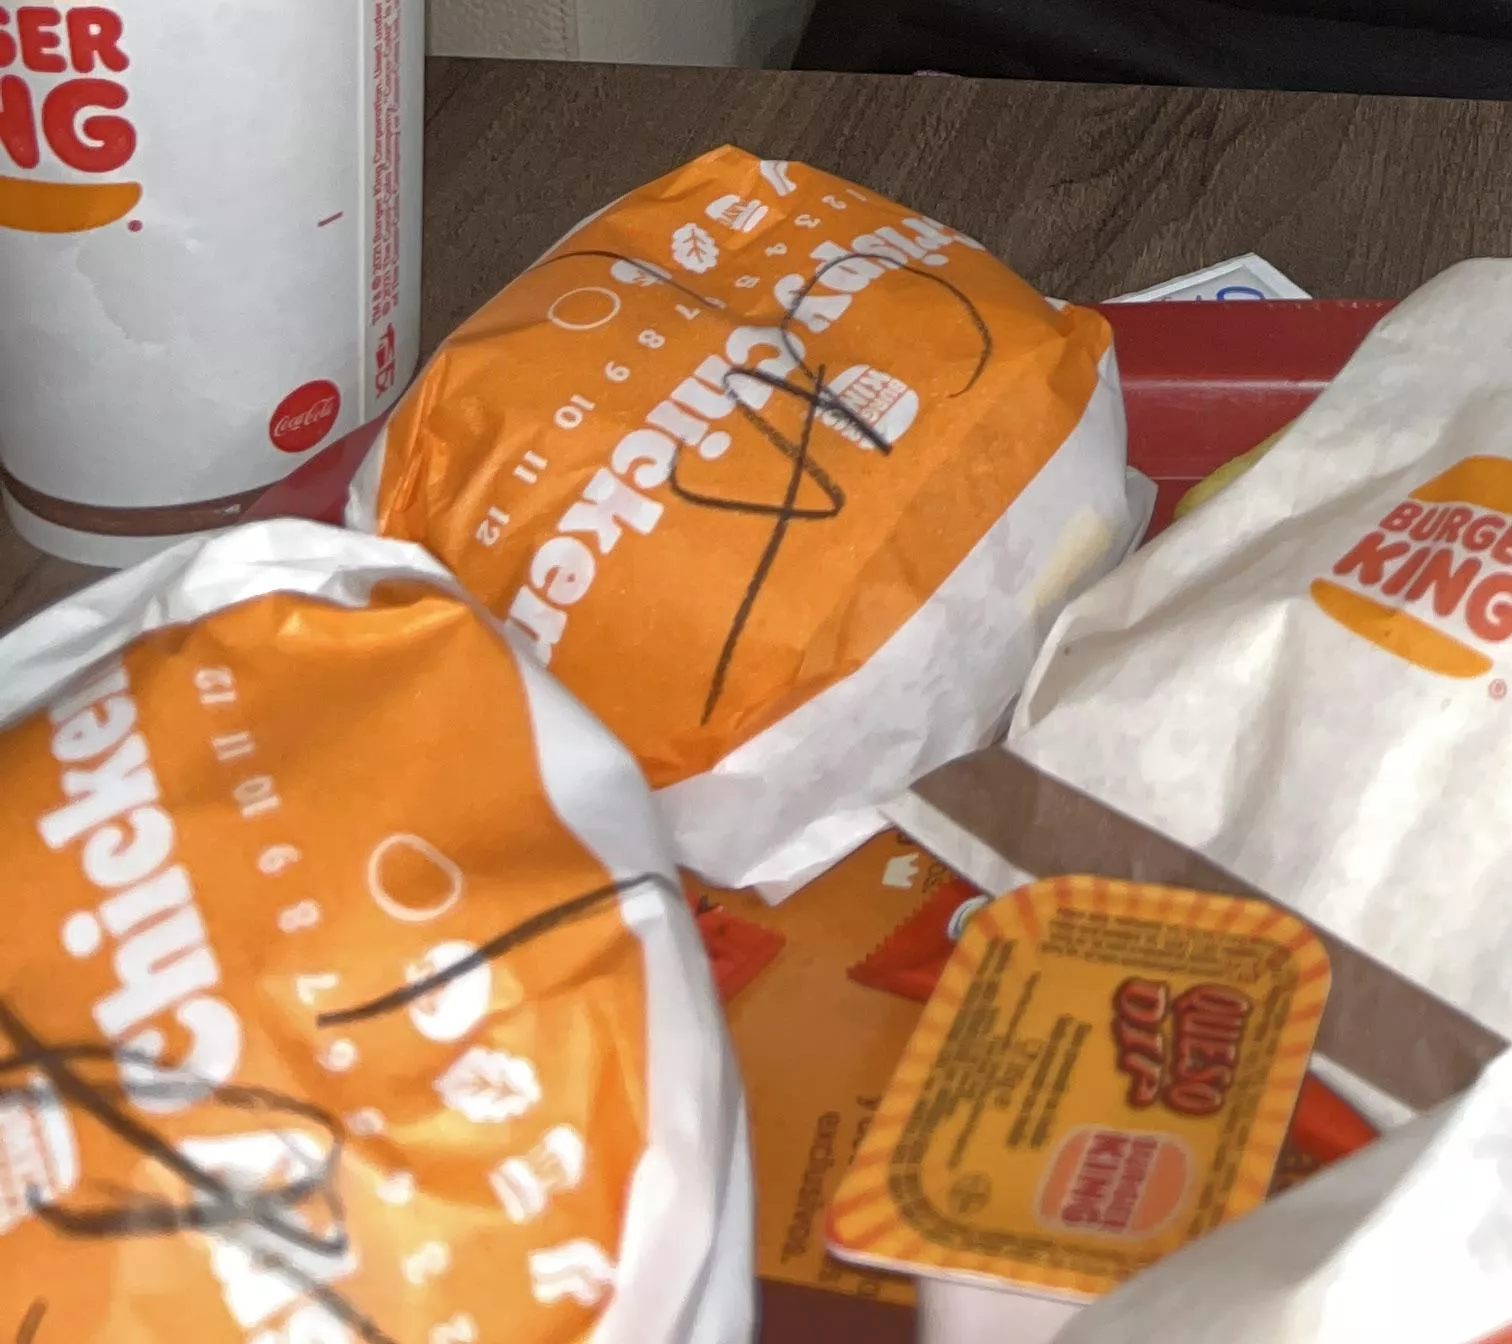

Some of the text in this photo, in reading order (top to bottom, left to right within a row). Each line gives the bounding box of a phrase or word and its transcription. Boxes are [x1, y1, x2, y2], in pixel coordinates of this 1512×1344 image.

[637, 328, 666, 350] 8
[604, 360, 631, 383] 9
[273, 396, 336, 437] Coca-Cola
[553, 393, 596, 430] 10
[513, 449, 549, 485] 11
[508, 325, 806, 668] Chicken
[475, 505, 511, 548] 12
[1111, 976, 1169, 1111] DIP
[1161, 984, 1253, 1119] QUESO
